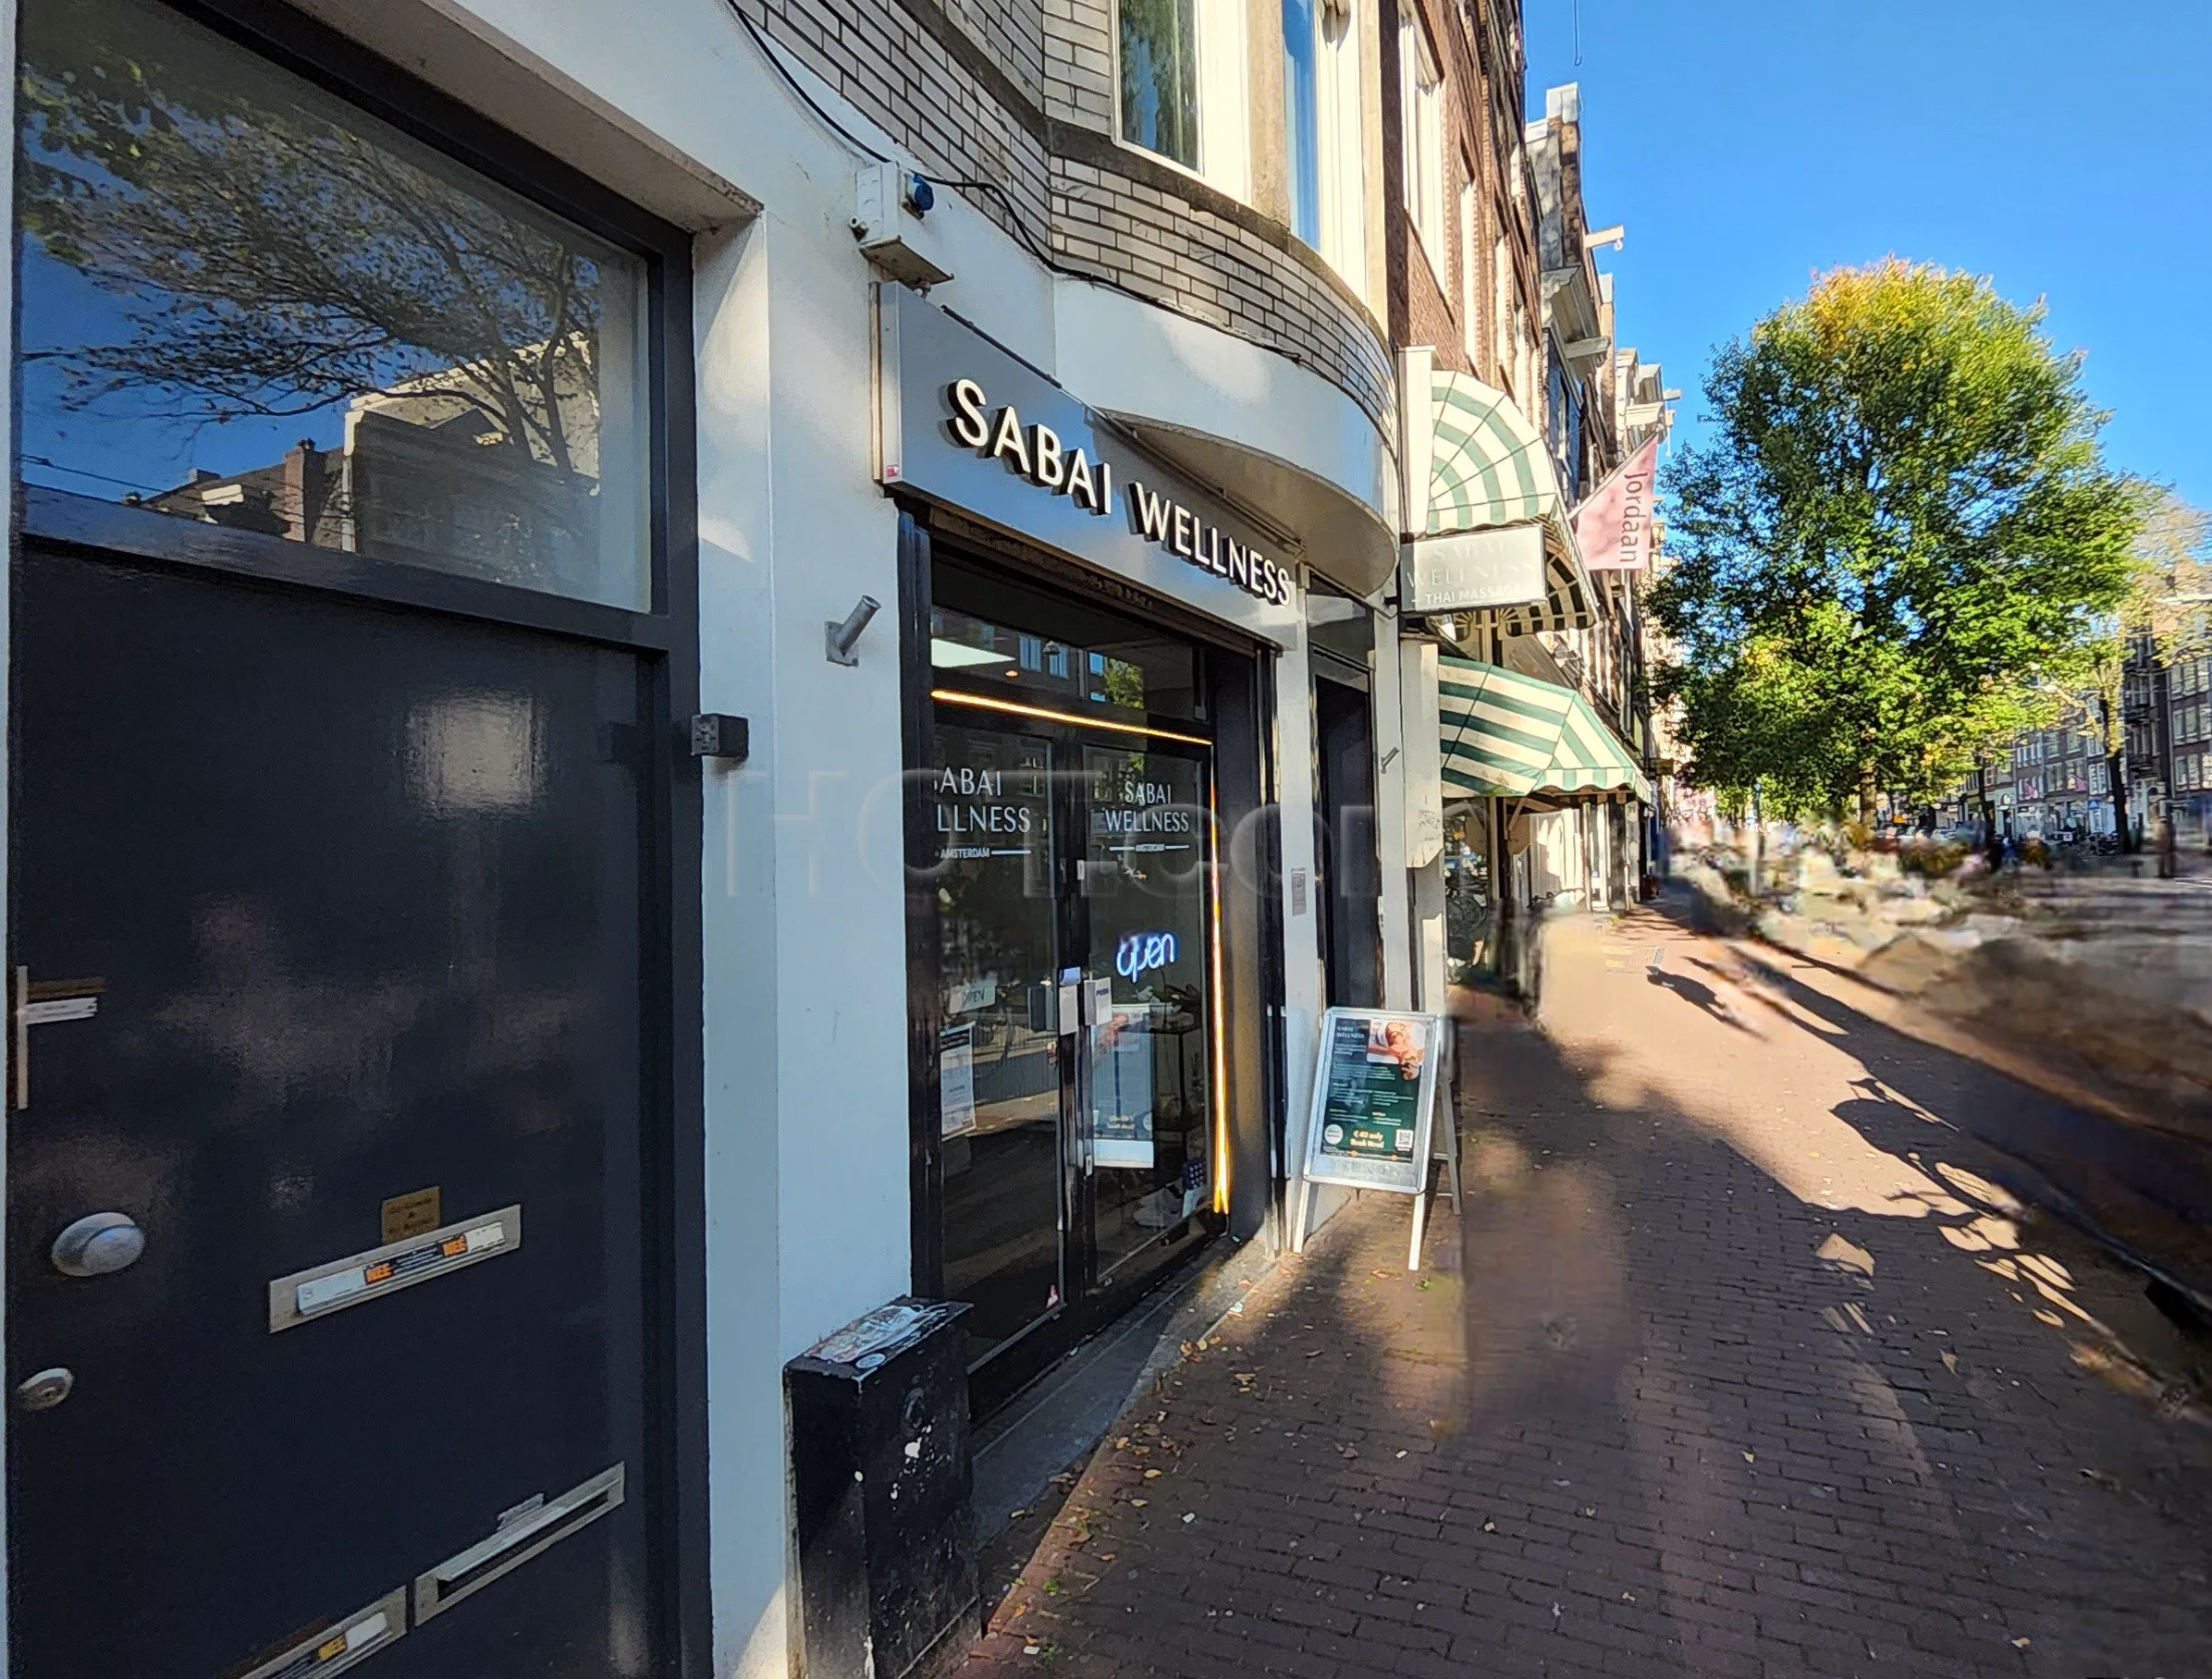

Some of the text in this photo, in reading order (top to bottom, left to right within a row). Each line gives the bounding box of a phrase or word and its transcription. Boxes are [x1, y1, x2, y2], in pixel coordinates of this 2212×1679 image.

[949, 378, 1291, 607] SABAI WELLNESS
[1619, 472, 1648, 562] Jordaan
[1425, 591, 1456, 605] THAI
[934, 766, 1002, 796] ABAI
[1124, 780, 1172, 805] SABAI
[937, 803, 1030, 832] LLNESS
[1105, 809, 1189, 832] WELLNESS
